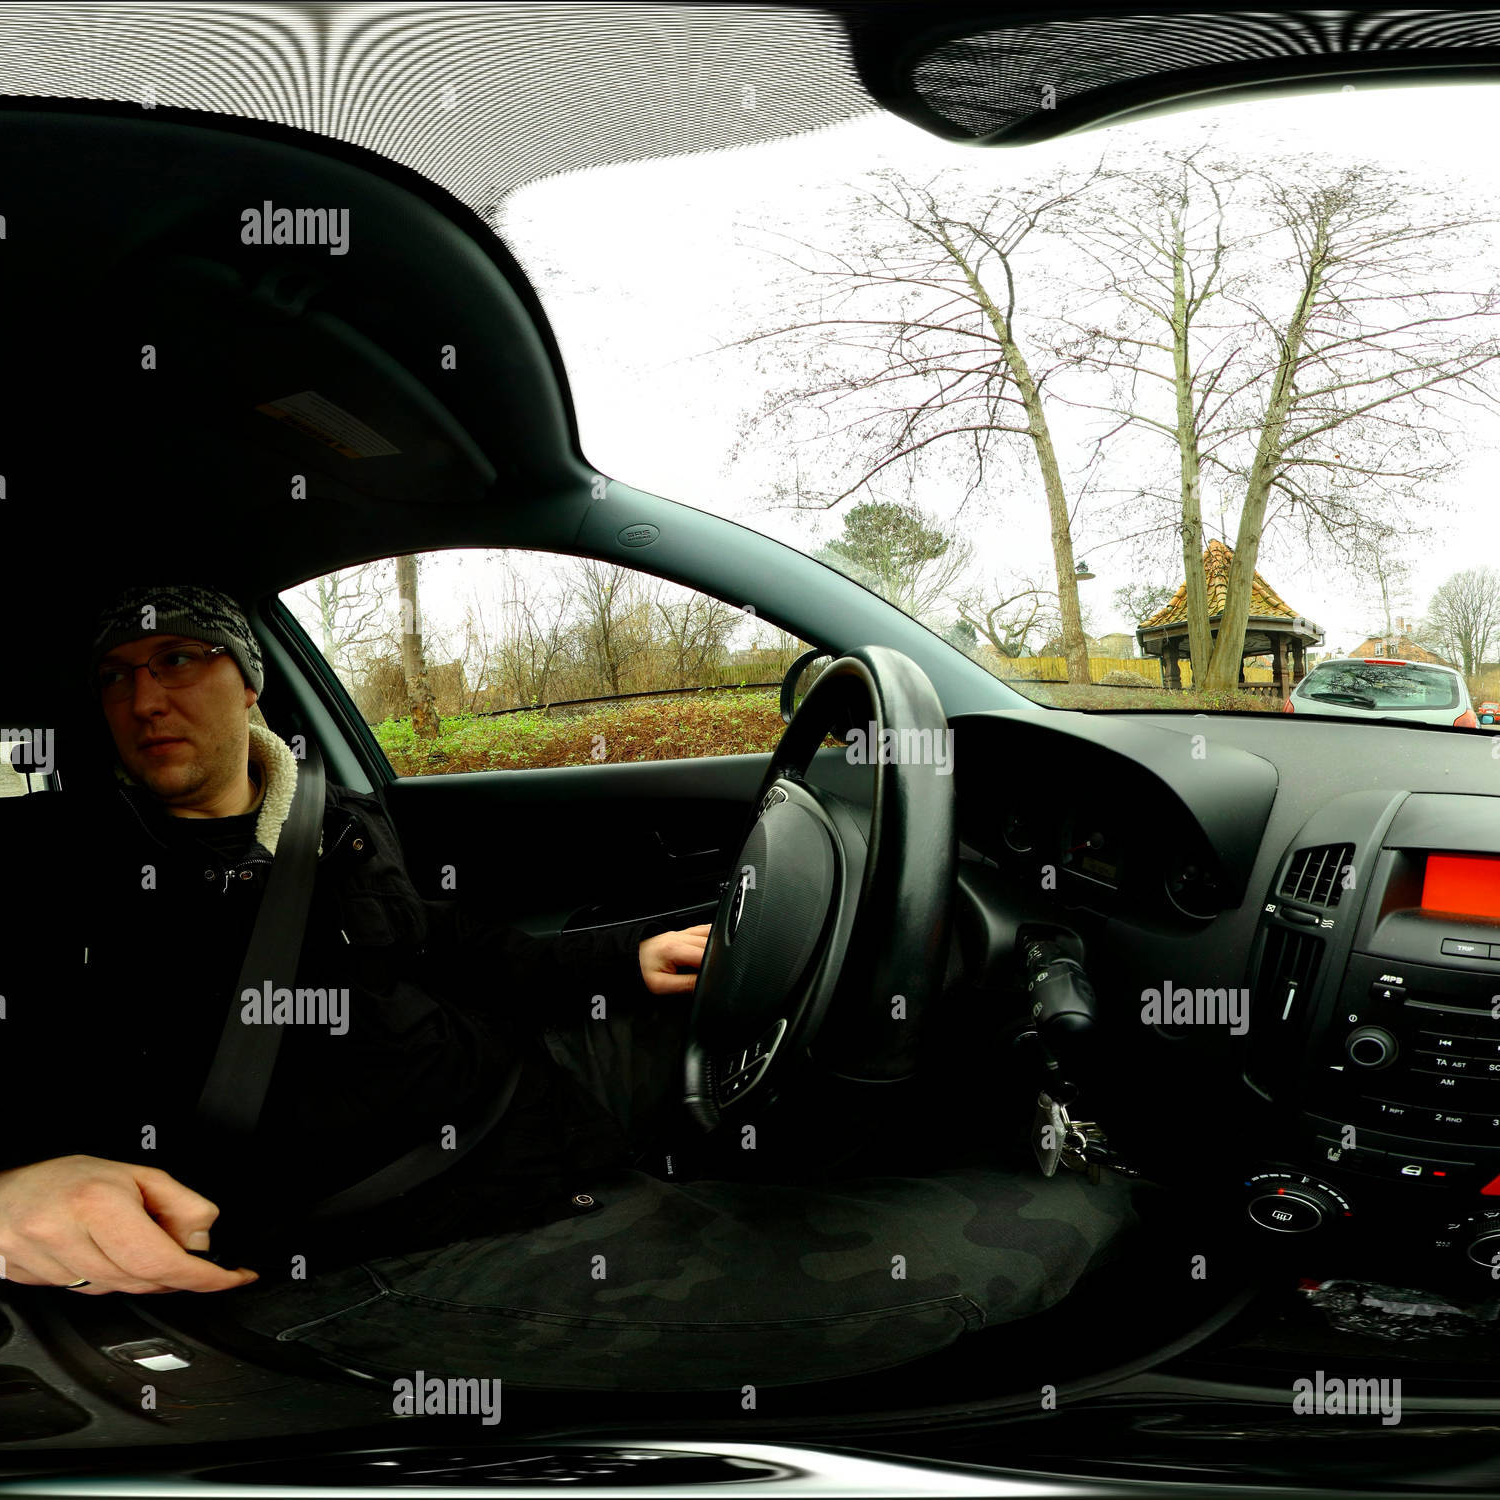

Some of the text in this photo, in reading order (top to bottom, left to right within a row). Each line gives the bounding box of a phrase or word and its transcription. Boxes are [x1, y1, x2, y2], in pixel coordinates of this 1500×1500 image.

[1436, 1058, 1467, 1069] TA AST
[1439, 1078, 1455, 1087] AM
[1380, 1104, 1386, 1112] 1
[1434, 1113, 1443, 1122] 2
[1492, 1118, 1500, 1127] 3
